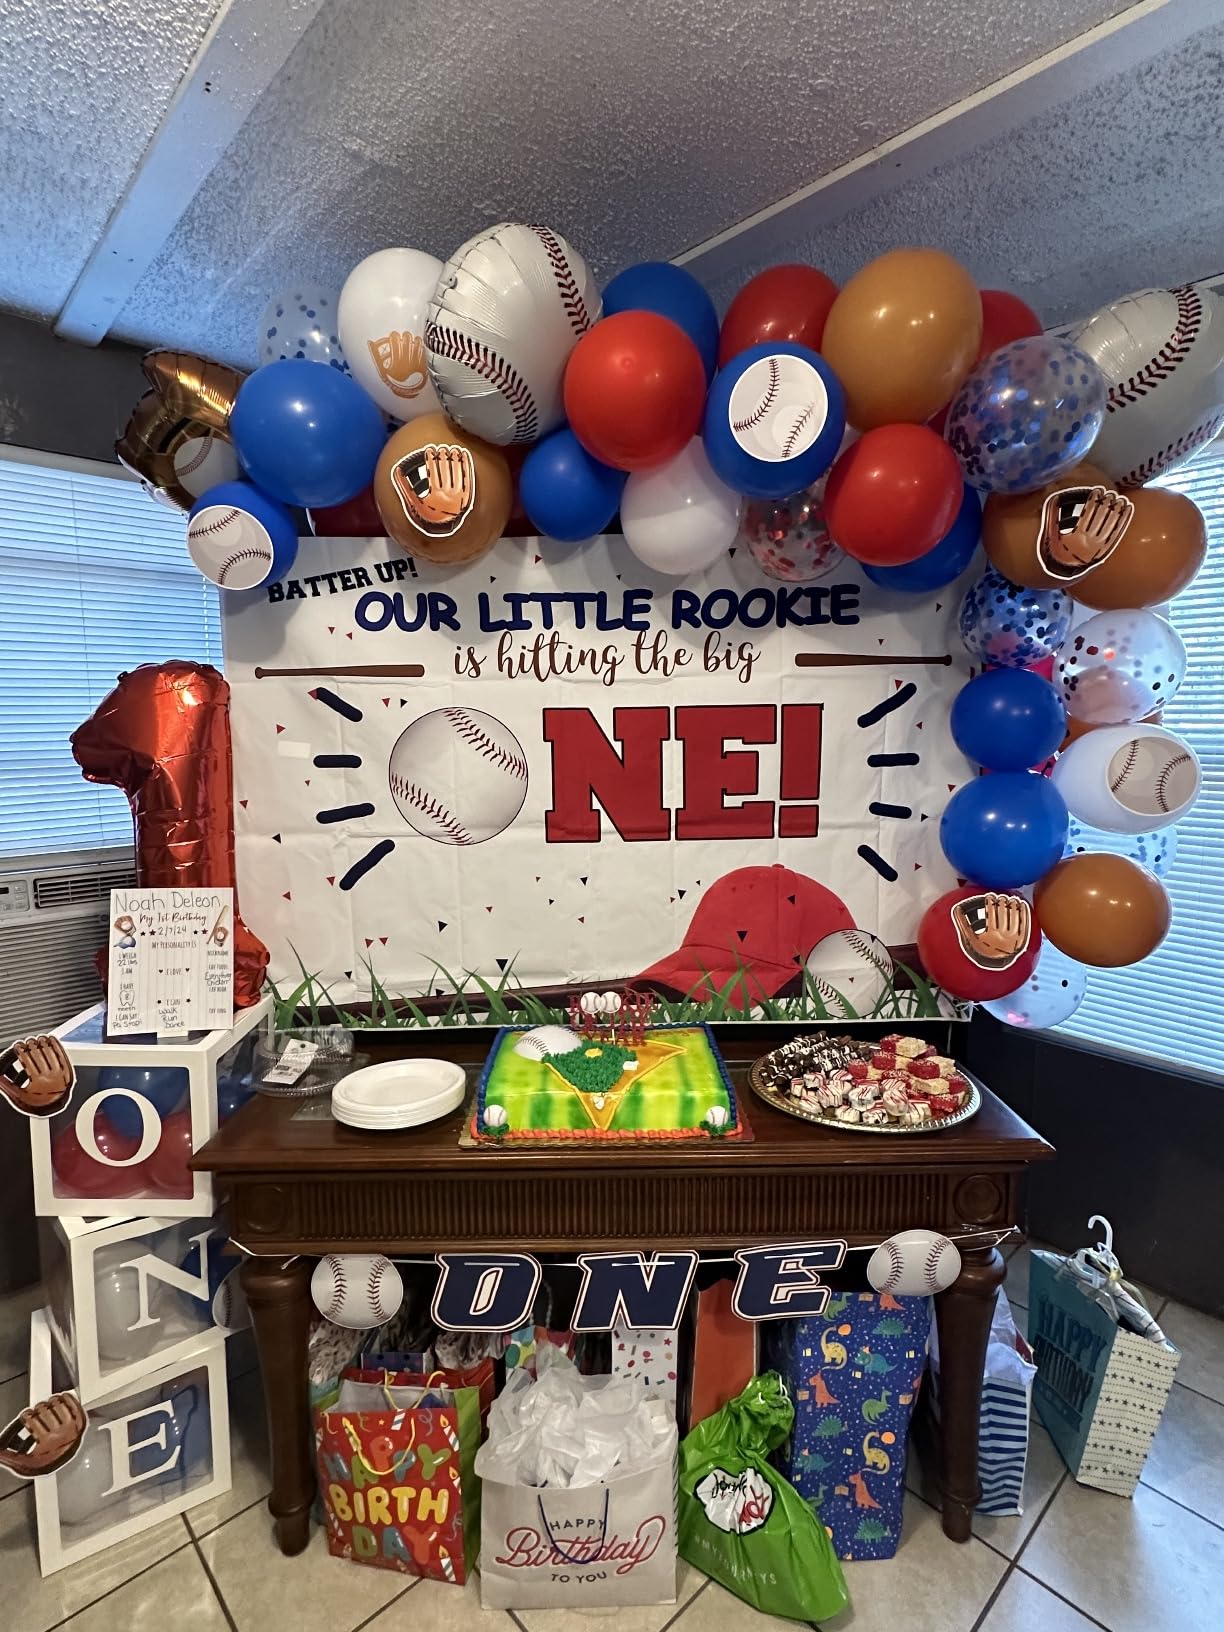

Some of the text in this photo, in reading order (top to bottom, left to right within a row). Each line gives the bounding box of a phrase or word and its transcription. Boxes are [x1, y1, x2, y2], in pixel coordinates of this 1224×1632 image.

[268, 557, 419, 603] BATTER UP!
[355, 584, 860, 632] OUR LITTLE ROOKIE
[454, 629, 761, 686] is hitting the big
[115, 890, 221, 914] Noah Deleon
[139, 912, 207, 927] My 1st Birthday
[322, 1436, 452, 1489] HAPPY
[328, 1484, 450, 1525] BIRTH
[550, 1518, 606, 1532] HAPPY
[351, 1524, 440, 1566] DAY
[495, 1514, 667, 1575] Birthday
[551, 1571, 608, 1584] TO YOU
